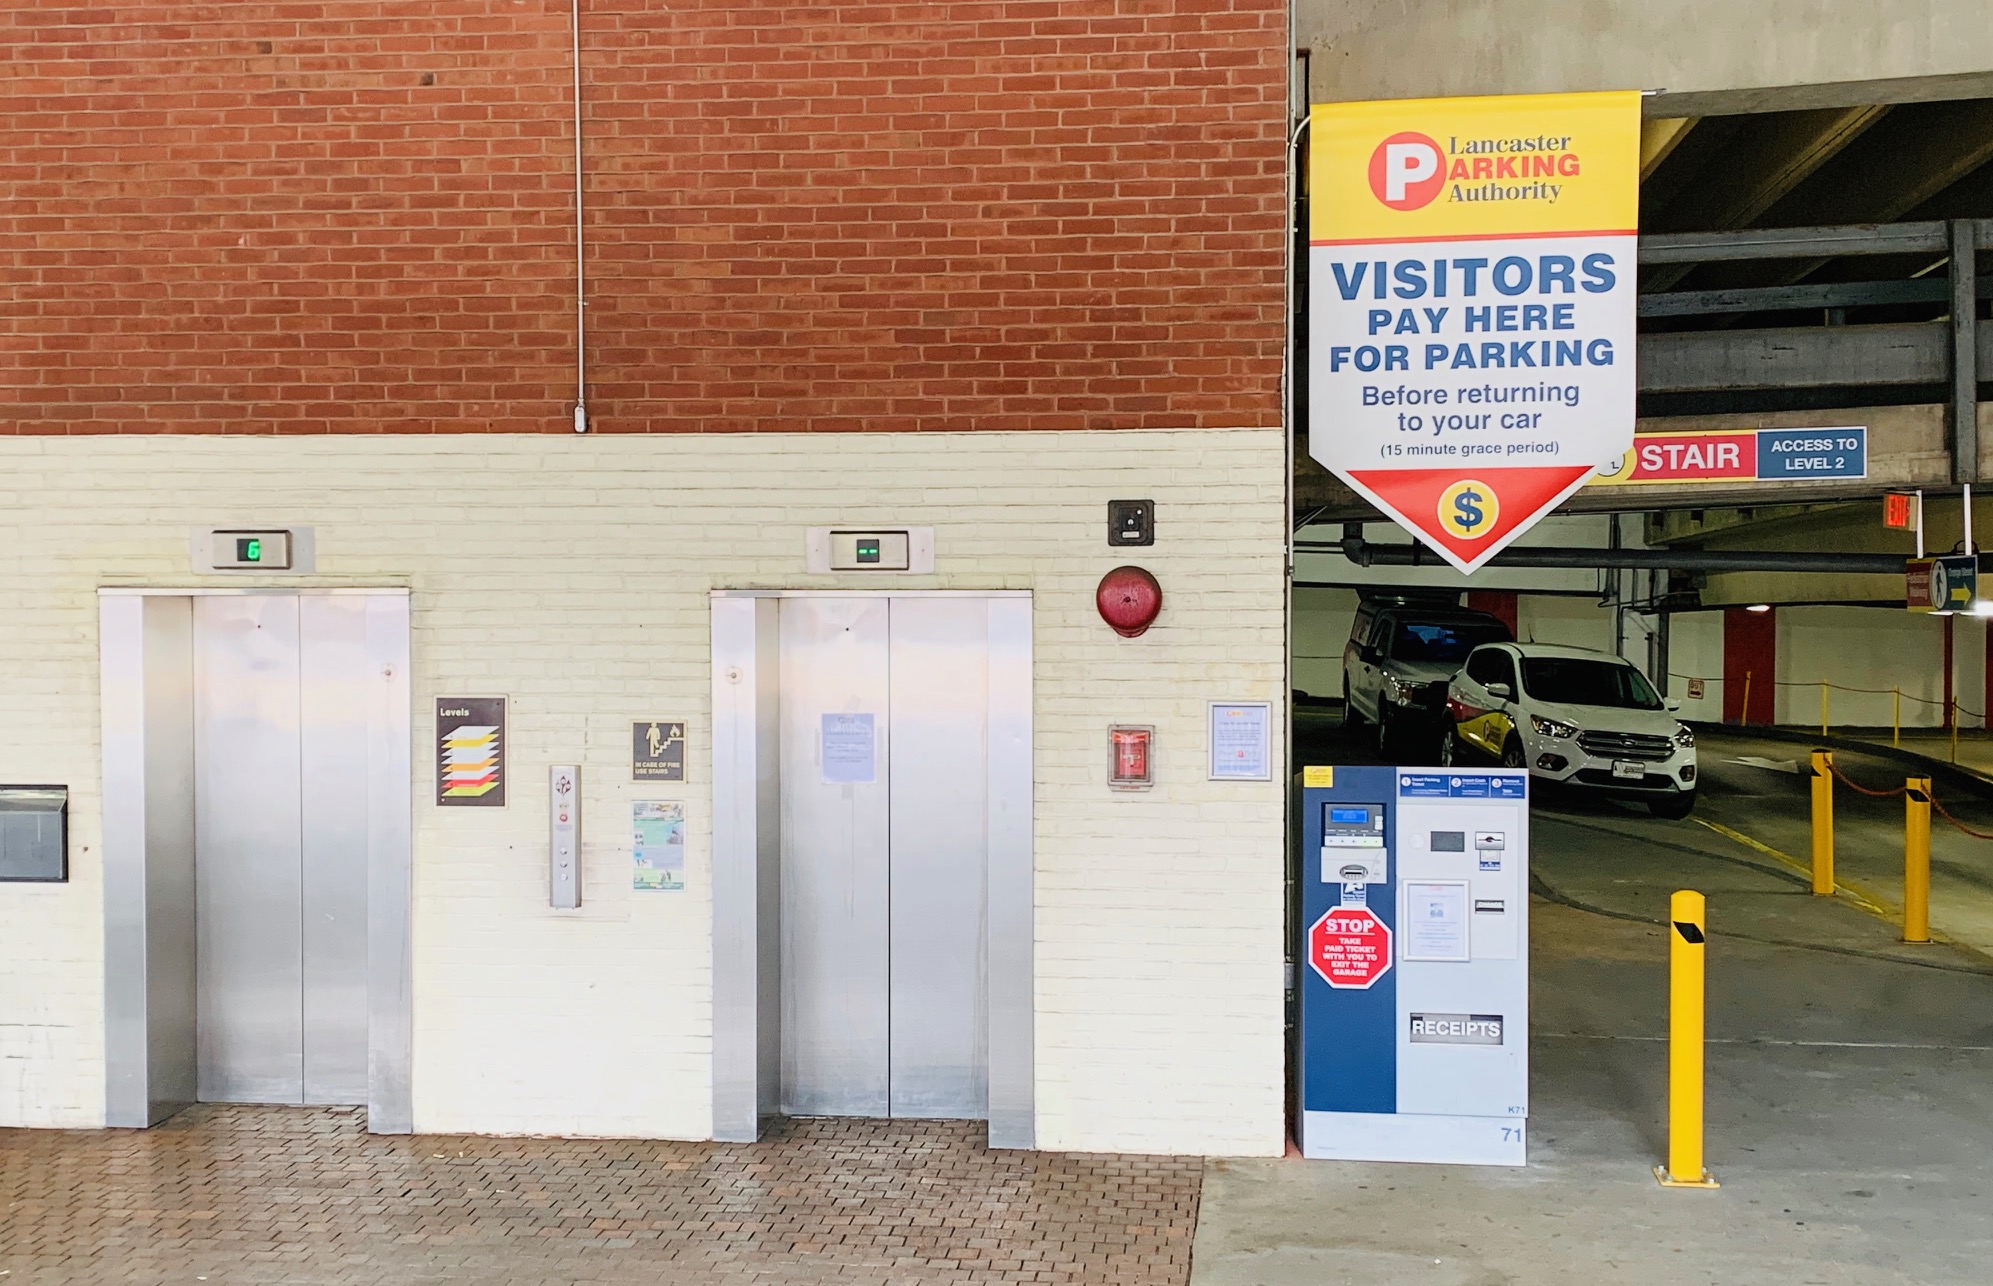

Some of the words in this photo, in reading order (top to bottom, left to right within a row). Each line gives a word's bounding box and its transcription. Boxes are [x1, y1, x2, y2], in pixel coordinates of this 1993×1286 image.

[1449, 135, 1572, 155] Lancaster
[1447, 181, 1563, 204] Authority
[1331, 253, 1616, 300] VISITORS
[1368, 307, 1449, 335] PAY
[1465, 303, 1575, 332] HERE
[1330, 345, 1409, 372] FOR
[1425, 339, 1614, 370] PARKING
[1362, 385, 1448, 406] Before
[1457, 382, 1580, 407] returning
[1398, 413, 1423, 431] to
[1432, 413, 1492, 436] your
[1500, 412, 1542, 429] car
[1380, 444, 1402, 458] (15
[1407, 443, 1456, 455] minute
[1461, 444, 1502, 457] grace
[1507, 441, 1560, 456] period)
[1771, 439, 1833, 453] ACCESS
[1835, 438, 1858, 451] TO
[1641, 443, 1740, 470] STAIR
[1785, 458, 1831, 471] LEVEL
[1835, 457, 1845, 469] 2
[440, 708, 469, 717] Levels
[1326, 919, 1375, 933] STOP
[1412, 1020, 1501, 1037] RECEIPTS
[1508, 1106, 1525, 1114] K71
[1501, 1127, 1521, 1142] 71
